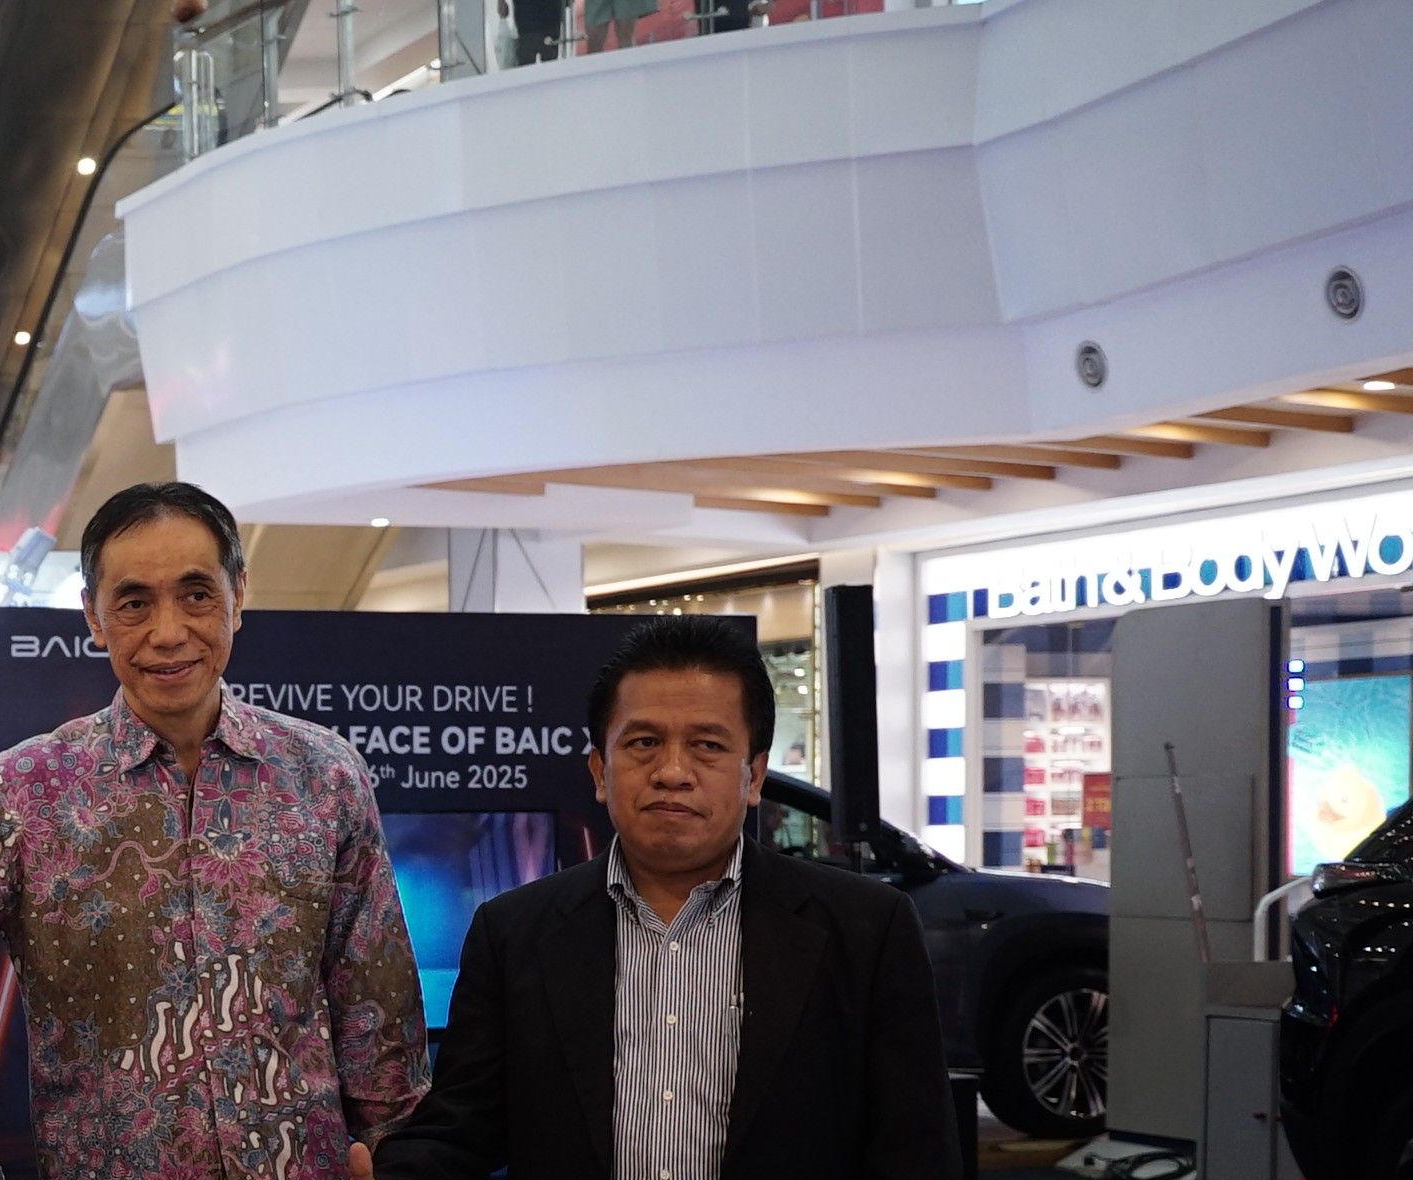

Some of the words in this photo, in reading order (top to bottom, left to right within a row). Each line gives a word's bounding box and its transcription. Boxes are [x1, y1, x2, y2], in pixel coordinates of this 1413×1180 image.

[10, 635, 110, 658] BAIC
[340, 684, 424, 712] YOUR
[433, 685, 518, 712] DRIVE
[349, 726, 432, 755] FACE
[441, 726, 486, 755] OF
[495, 727, 573, 755] BAIC
[401, 765, 461, 789] June
[467, 765, 528, 789] 2025
